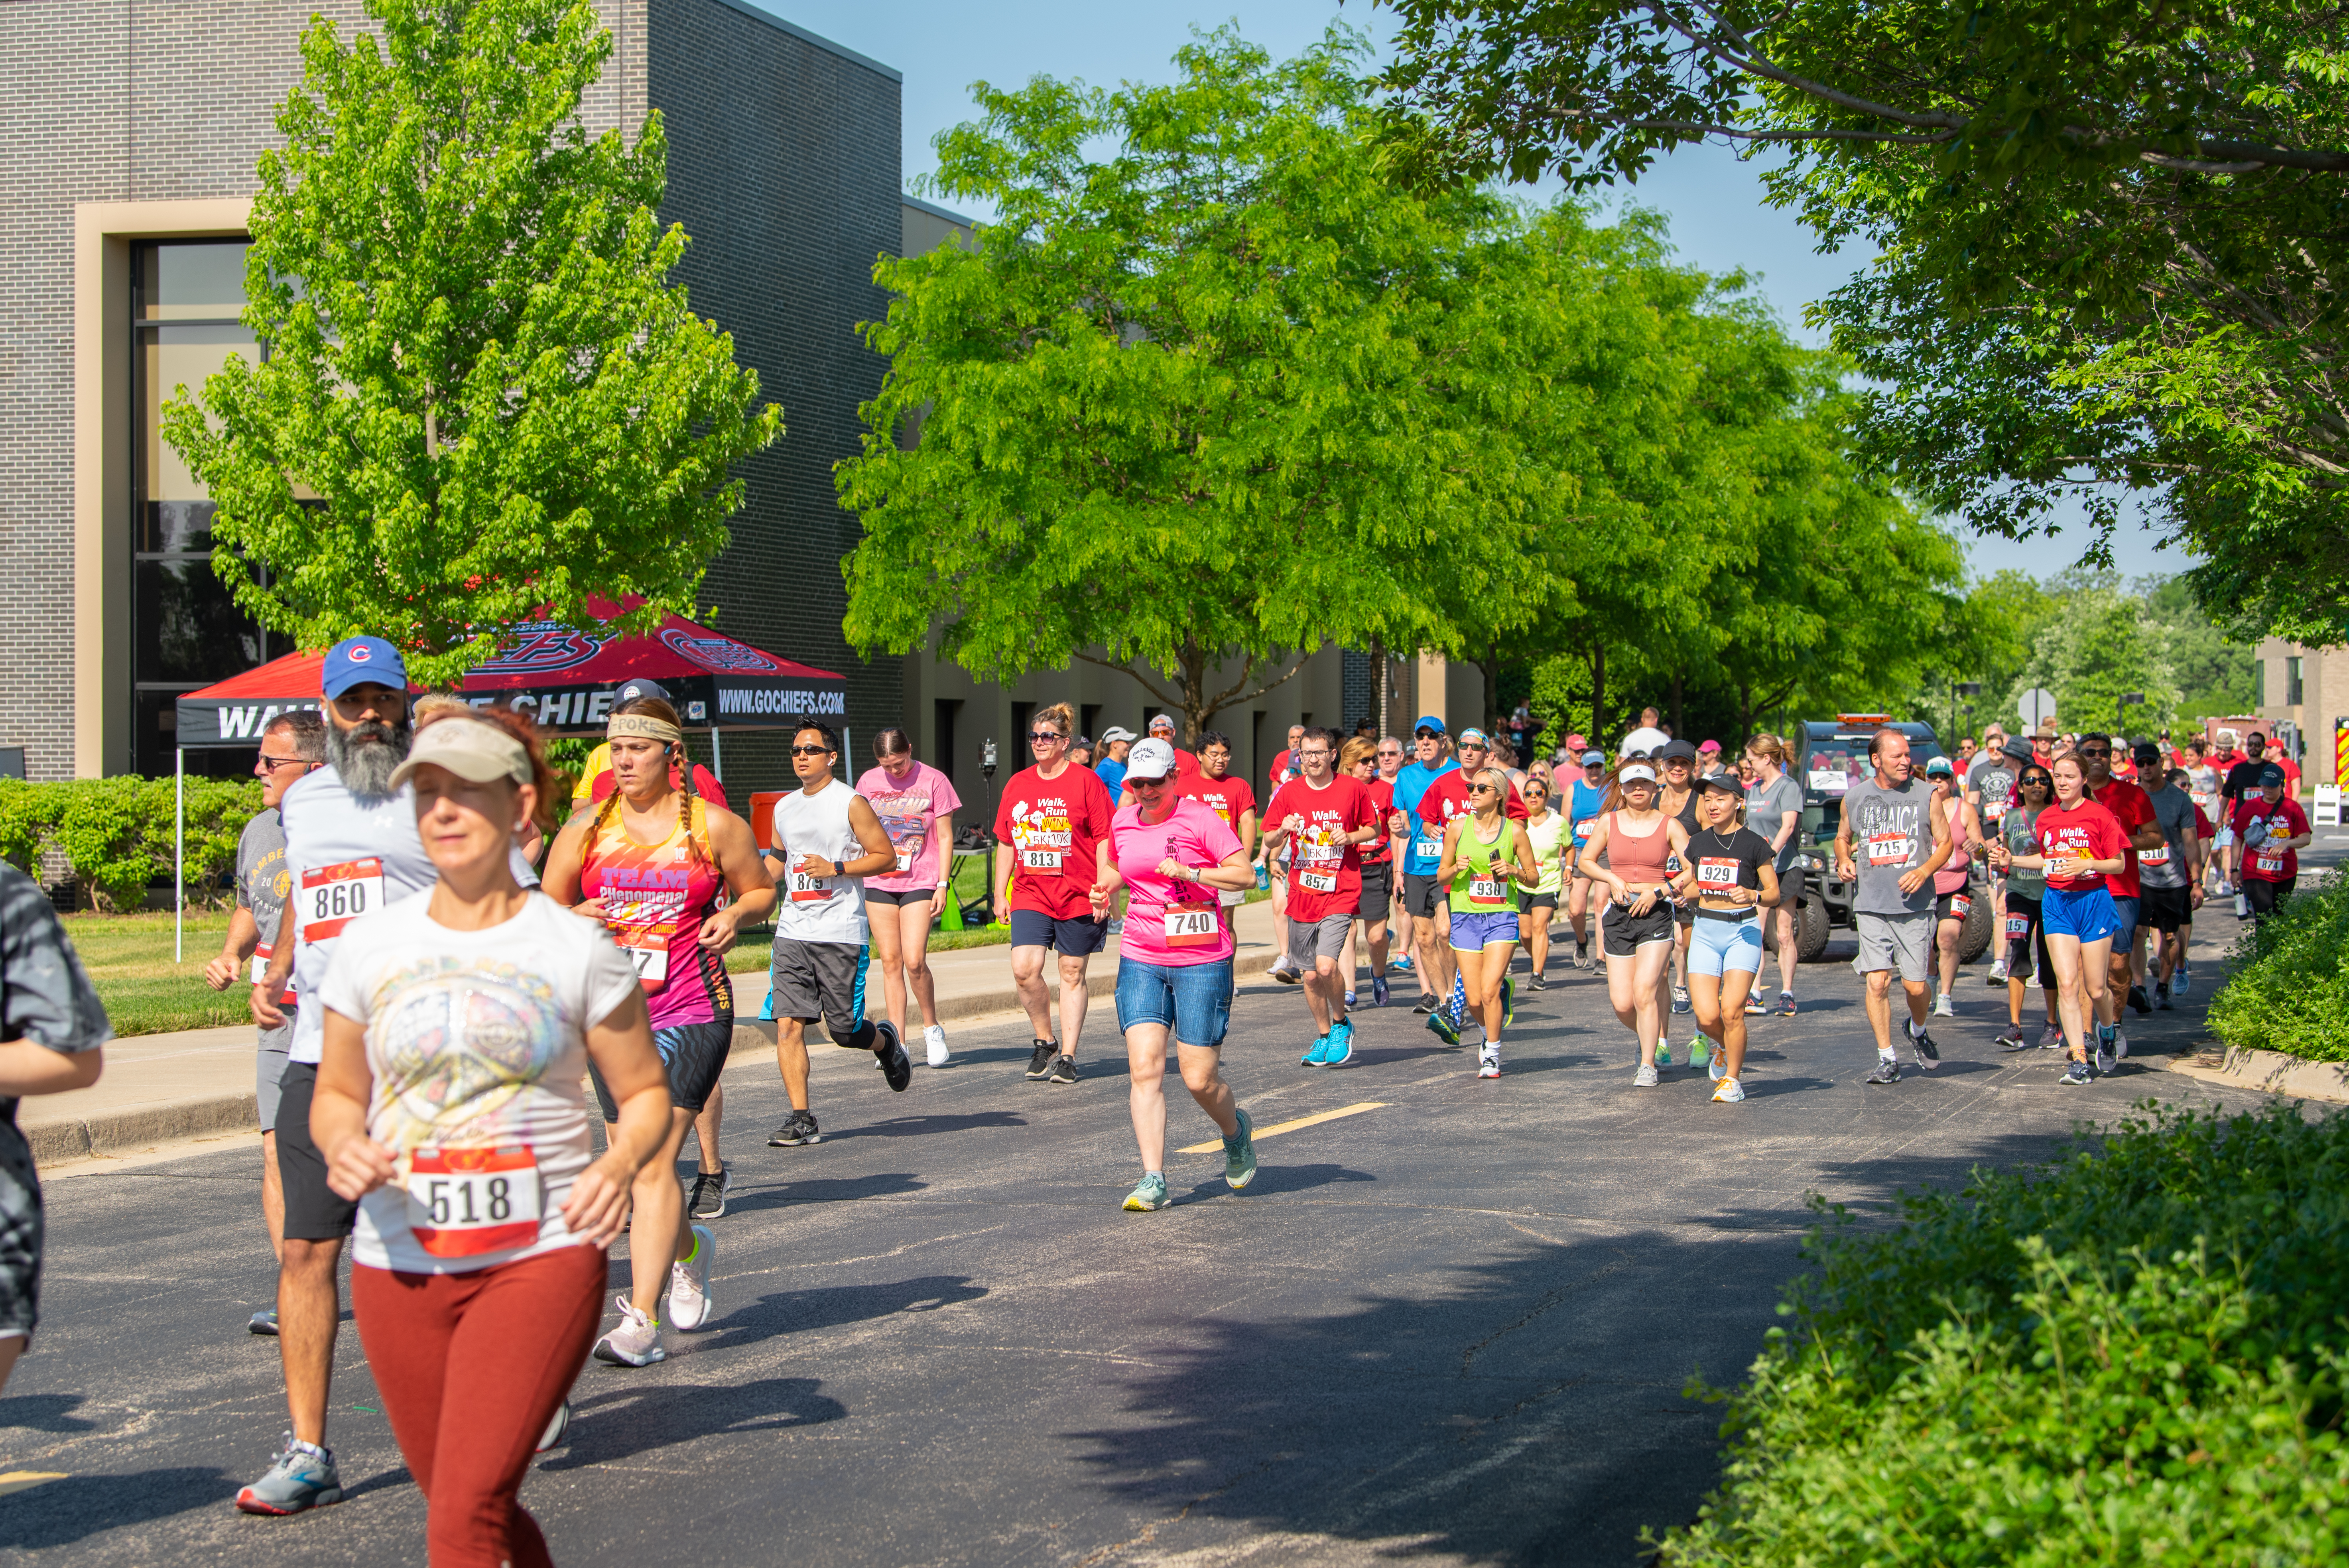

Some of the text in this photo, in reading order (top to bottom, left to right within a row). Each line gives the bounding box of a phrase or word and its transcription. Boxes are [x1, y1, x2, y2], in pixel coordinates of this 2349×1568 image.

[719, 689, 845, 714] WWW.GOCHIEFS.COM
[510, 691, 616, 725] CHIE
[869, 790, 904, 802] Racing
[1203, 793, 1226, 802] Walk,
[1038, 798, 1066, 807] Walk,
[1211, 801, 1227, 810] Run
[1046, 807, 1067, 816] Run
[1312, 810, 1342, 821] Walk,
[1323, 821, 1343, 830] Run
[1581, 825, 1594, 834] 70
[2060, 827, 2088, 838] Walk,
[1876, 841, 1900, 856] 715
[2068, 838, 2089, 847] Run
[1166, 845, 1177, 854] 10k
[1423, 844, 1436, 855] 12
[2145, 849, 2163, 858] 510
[1031, 852, 1054, 866] 813
[2262, 860, 2278, 870] 874
[249, 848, 286, 886] LAMBE
[601, 867, 689, 889] TEAM
[1705, 867, 1730, 881] 929
[798, 874, 823, 890] 879
[1305, 874, 1329, 890] 857
[600, 886, 689, 904] PHenomenal
[1477, 882, 1500, 896] 930
[315, 882, 366, 919] 860
[1957, 901, 1969, 914] 90
[651, 924, 677, 934] LUNGS
[1175, 913, 1210, 934] 740
[427, 1177, 512, 1224] 518
